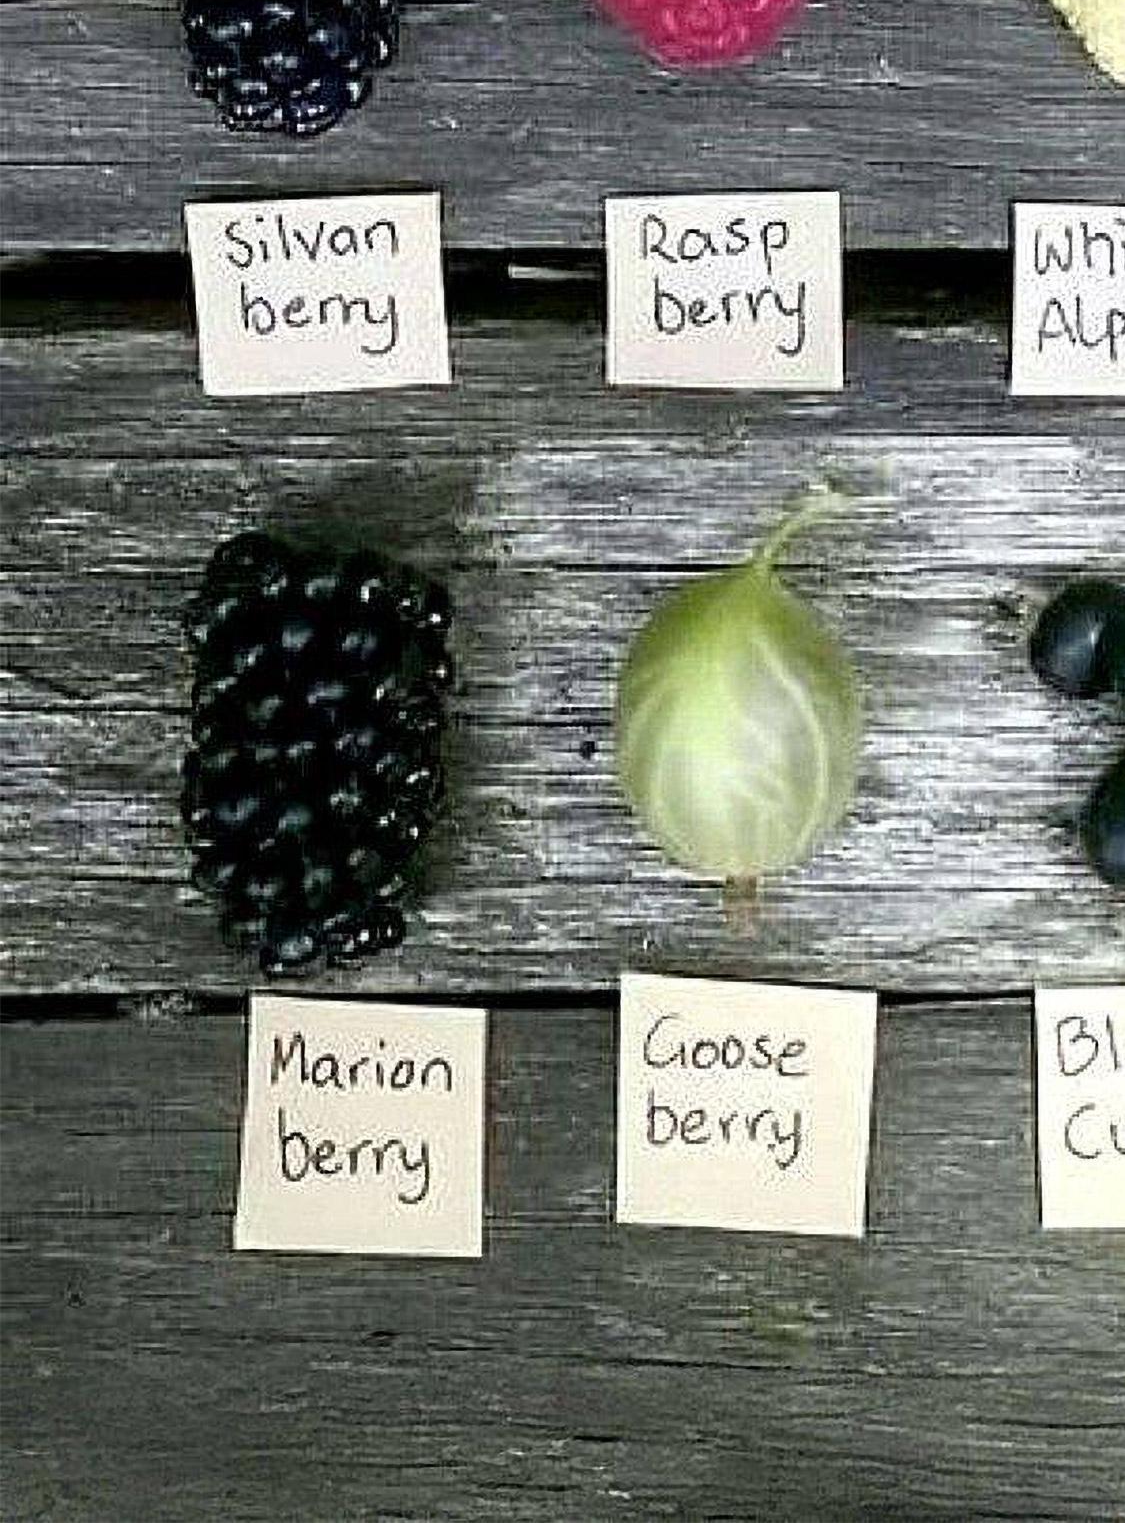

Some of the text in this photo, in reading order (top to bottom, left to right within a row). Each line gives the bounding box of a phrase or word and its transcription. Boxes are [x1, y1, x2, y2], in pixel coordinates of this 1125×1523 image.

[225, 214, 399, 269] Silvan
[642, 214, 789, 275] Rasp
[241, 282, 399, 357] berry
[654, 276, 805, 357] berry
[271, 1031, 452, 1092] Marion
[644, 1016, 808, 1076] Goose
[278, 1107, 430, 1205] berry
[647, 1090, 800, 1170] berry
